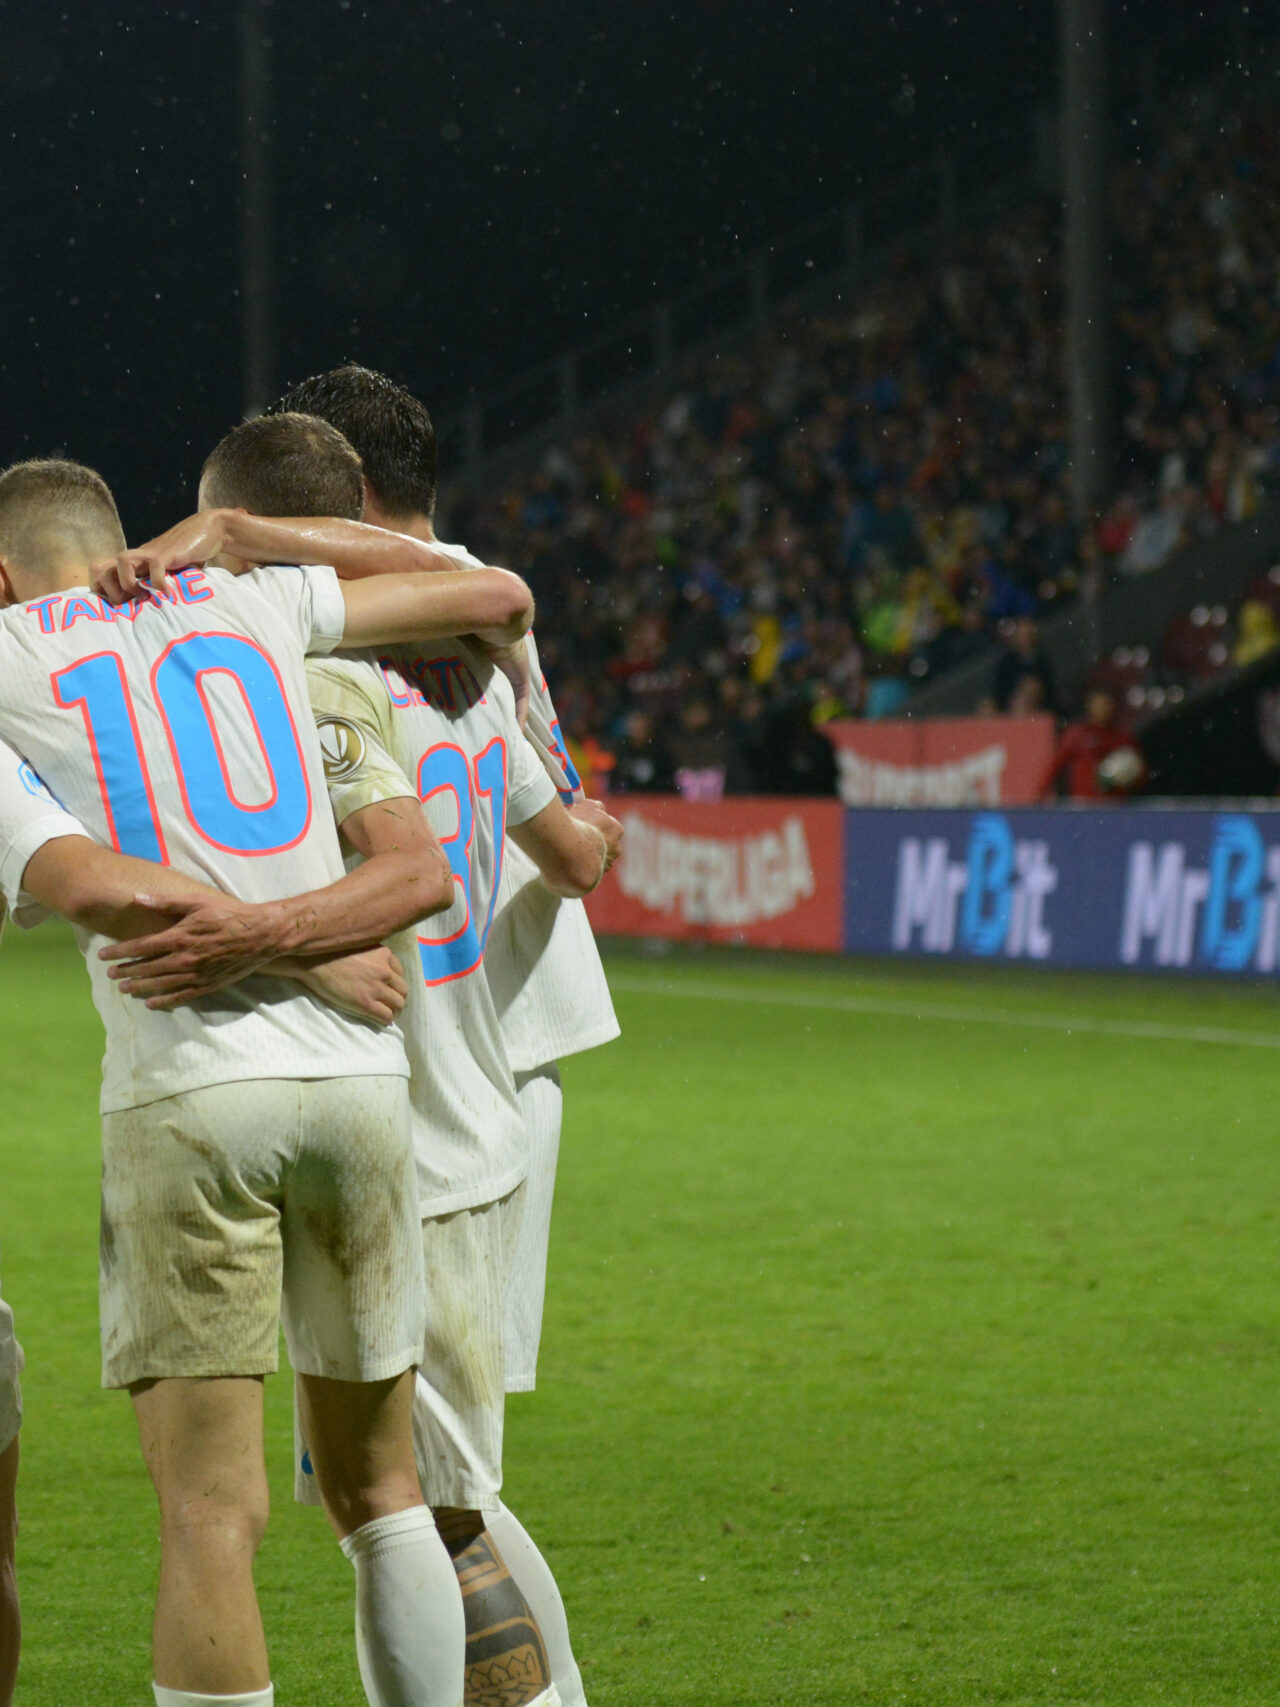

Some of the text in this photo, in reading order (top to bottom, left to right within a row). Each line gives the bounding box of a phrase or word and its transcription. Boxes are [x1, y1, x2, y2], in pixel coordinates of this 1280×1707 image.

[26, 567, 215, 634] TANE
[50, 630, 313, 866] 10
[891, 812, 1058, 959] MrBit
[1120, 813, 1280, 972] MrBi
